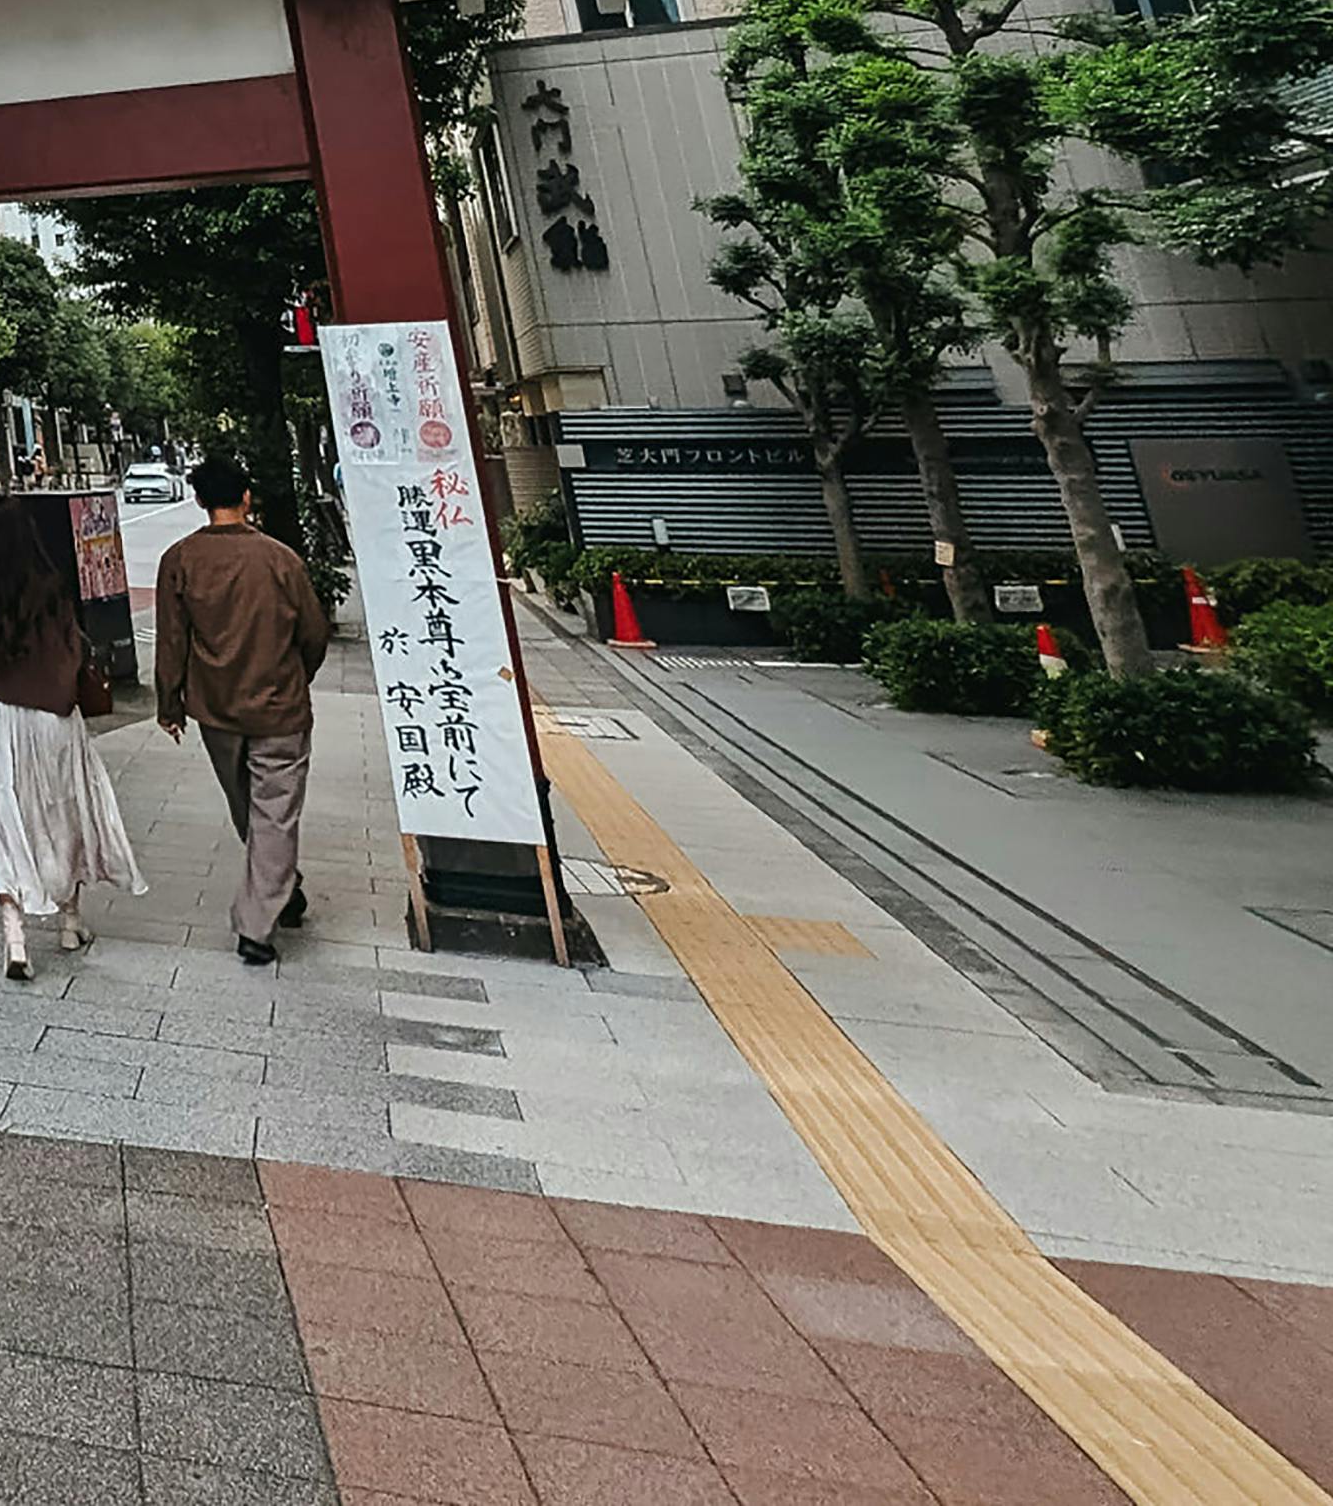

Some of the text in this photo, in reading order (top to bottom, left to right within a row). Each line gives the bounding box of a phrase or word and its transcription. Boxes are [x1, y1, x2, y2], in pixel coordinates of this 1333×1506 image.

[616, 447, 806, 465] 芝大門フロントビル
[430, 467, 475, 530] 秘仏
